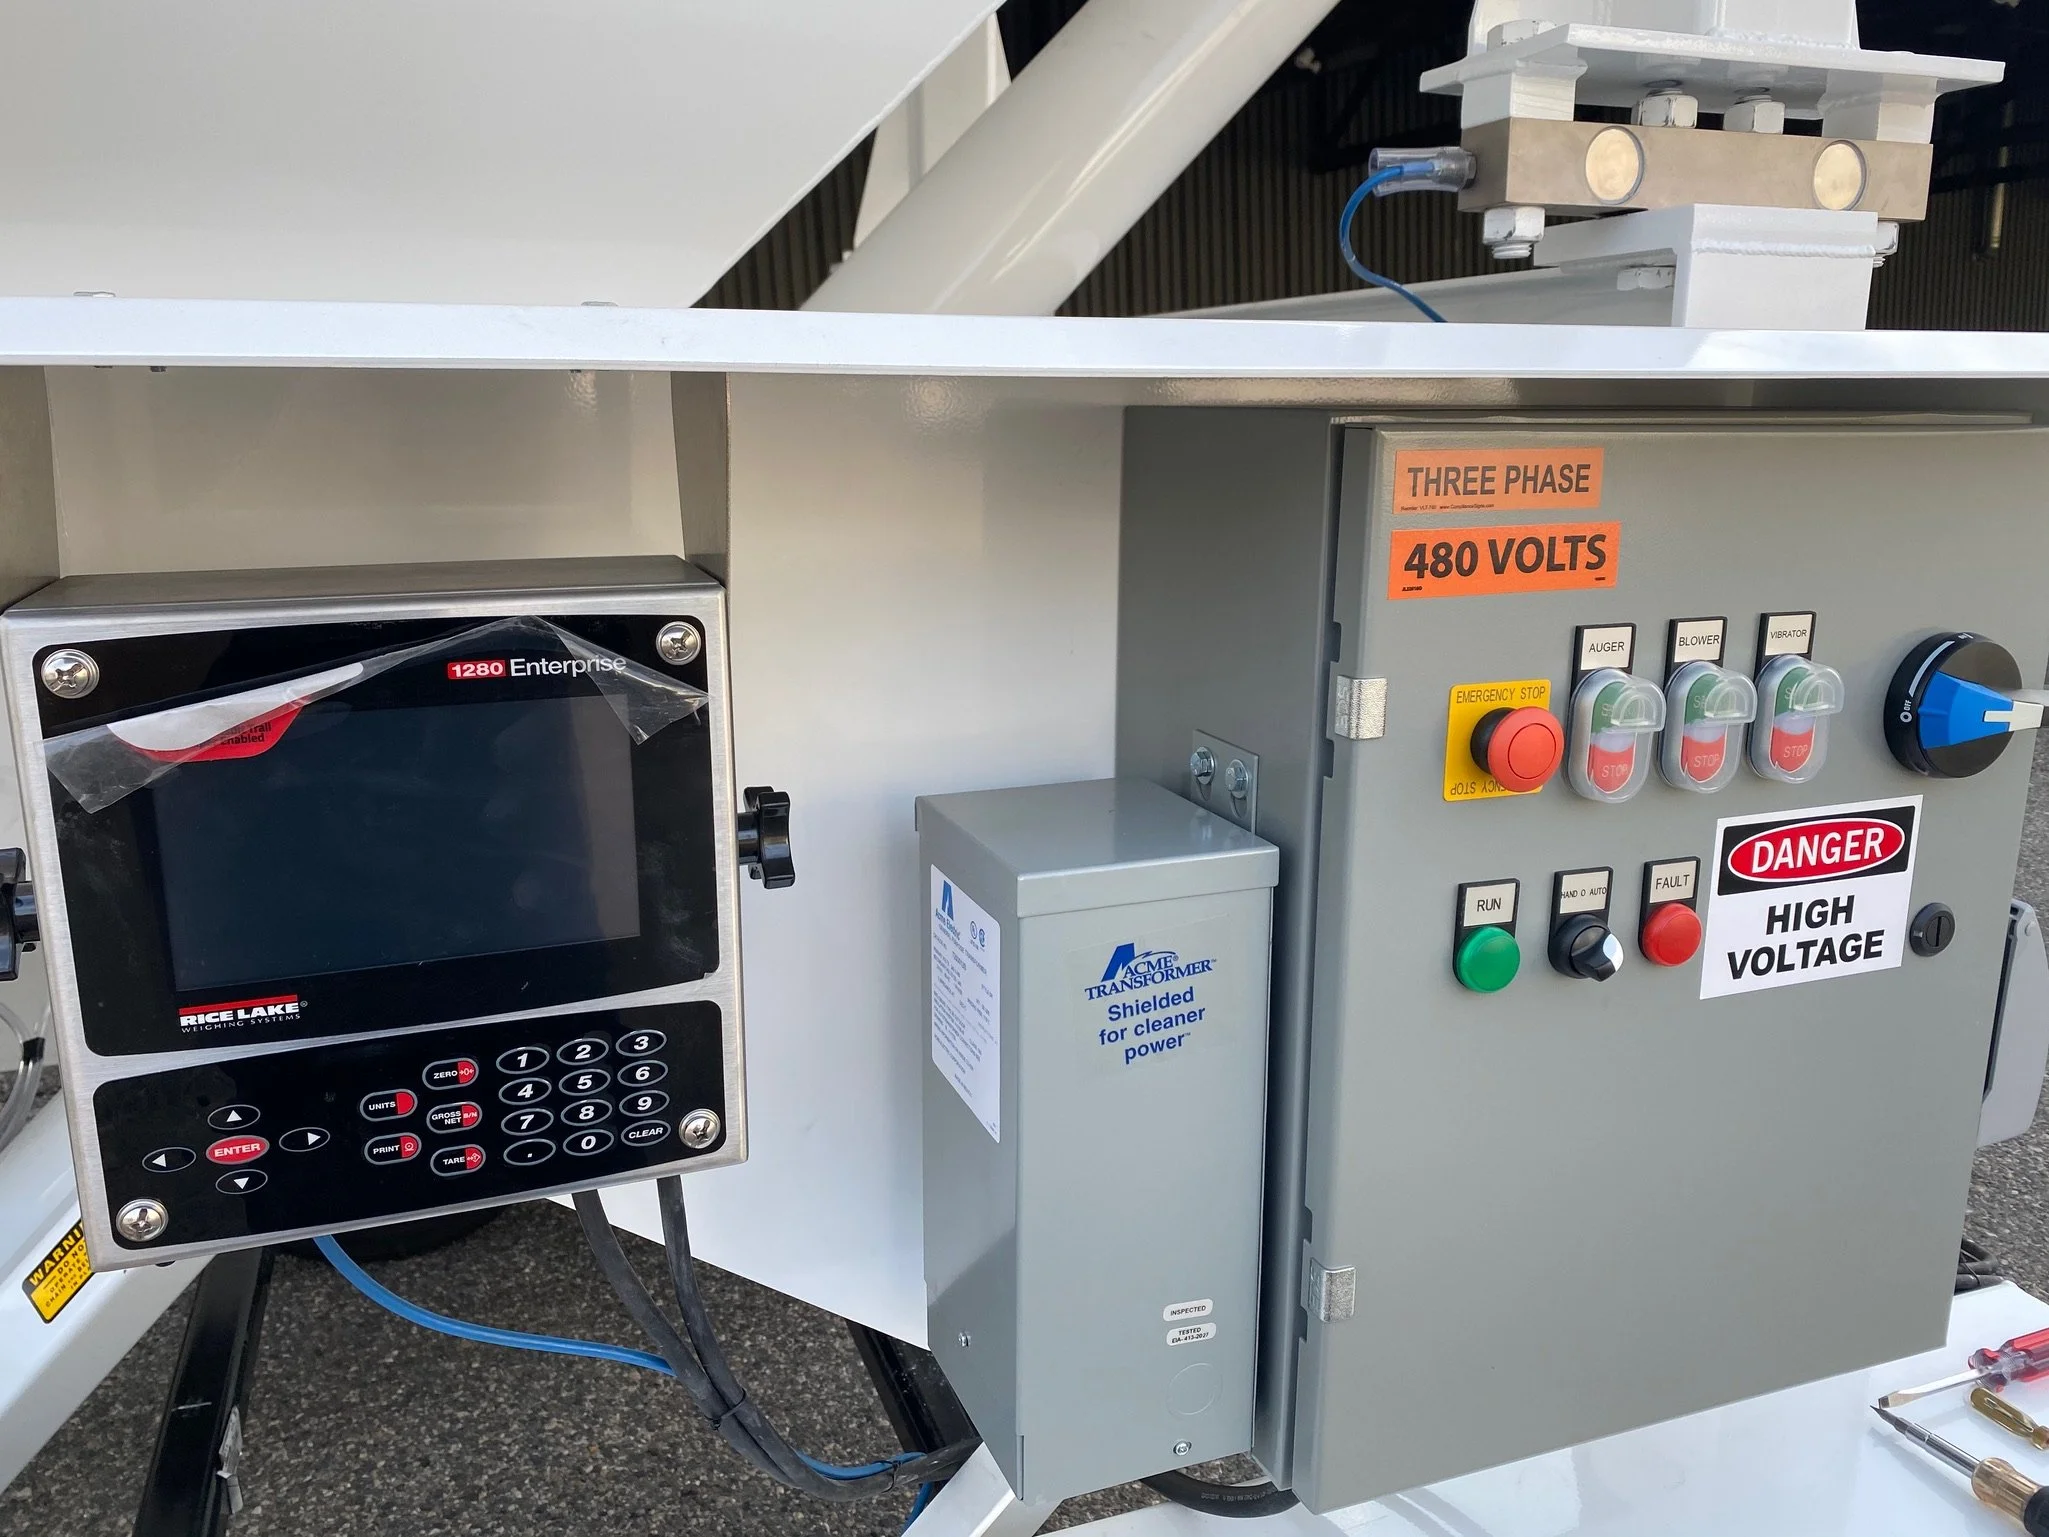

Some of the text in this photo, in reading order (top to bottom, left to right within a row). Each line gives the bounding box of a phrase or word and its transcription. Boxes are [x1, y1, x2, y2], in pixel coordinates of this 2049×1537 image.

[1408, 463, 1591, 498] THREE PHASE
[1404, 534, 1606, 579] 480 VOLTS
[1678, 634, 1720, 648] BLOWER
[1770, 629, 1808, 640] VIBRATOR
[1588, 640, 1625, 653] AUGER
[451, 655, 627, 678] 1280 Enterprise
[1456, 686, 1546, 704] EMERGENCY STOP
[1904, 700, 1912, 711] OFF
[1784, 745, 1808, 758] STOP
[1694, 754, 1720, 768] STOP
[1601, 765, 1629, 778] STOP
[1451, 782, 1477, 795] STOP
[1752, 828, 1886, 873] DANGER
[1655, 875, 1690, 890] FAULT
[1561, 890, 1579, 899] HAND
[1590, 887, 1607, 896] AUTO
[1477, 898, 1502, 912] RUN
[1766, 895, 1855, 935] HIGH
[1728, 929, 1885, 980] VOLTAGE
[1123, 955, 1174, 979] ACME
[1085, 959, 1213, 1000] TRANSFORMER
[1108, 986, 1194, 1021] Shielded
[180, 1003, 299, 1026] RICE LAKE
[181, 1013, 301, 1033] WEIGHING SYSTEMS
[1099, 1007, 1205, 1045] for cleaner
[633, 1036, 649, 1050] 3
[1125, 1033, 1184, 1064] power
[574, 1044, 592, 1060] 2
[517, 1053, 529, 1068] 1
[433, 1070, 458, 1079] ZERO
[635, 1066, 650, 1081] 6
[576, 1074, 593, 1090] 5
[517, 1083, 534, 1098] 4
[368, 1101, 396, 1111] UNITS
[637, 1096, 652, 1111] 9
[431, 1110, 461, 1121] GROSS
[463, 1111, 478, 1119] B/N
[579, 1105, 595, 1120] 8
[444, 1117, 461, 1125] NET
[519, 1114, 535, 1130] 7
[628, 1127, 664, 1139] CLEAR
[373, 1144, 400, 1155] PRINT
[580, 1135, 597, 1150] 0
[214, 1143, 261, 1158] ENTER
[442, 1156, 466, 1166] TARE
[29, 1222, 84, 1287] WARNI
[57, 1260, 70, 1275] DO
[71, 1243, 86, 1260] NO
[45, 1284, 67, 1308] CHAIN
[1170, 1305, 1206, 1316] INSPECTED
[1178, 1327, 1201, 1336] TESTED
